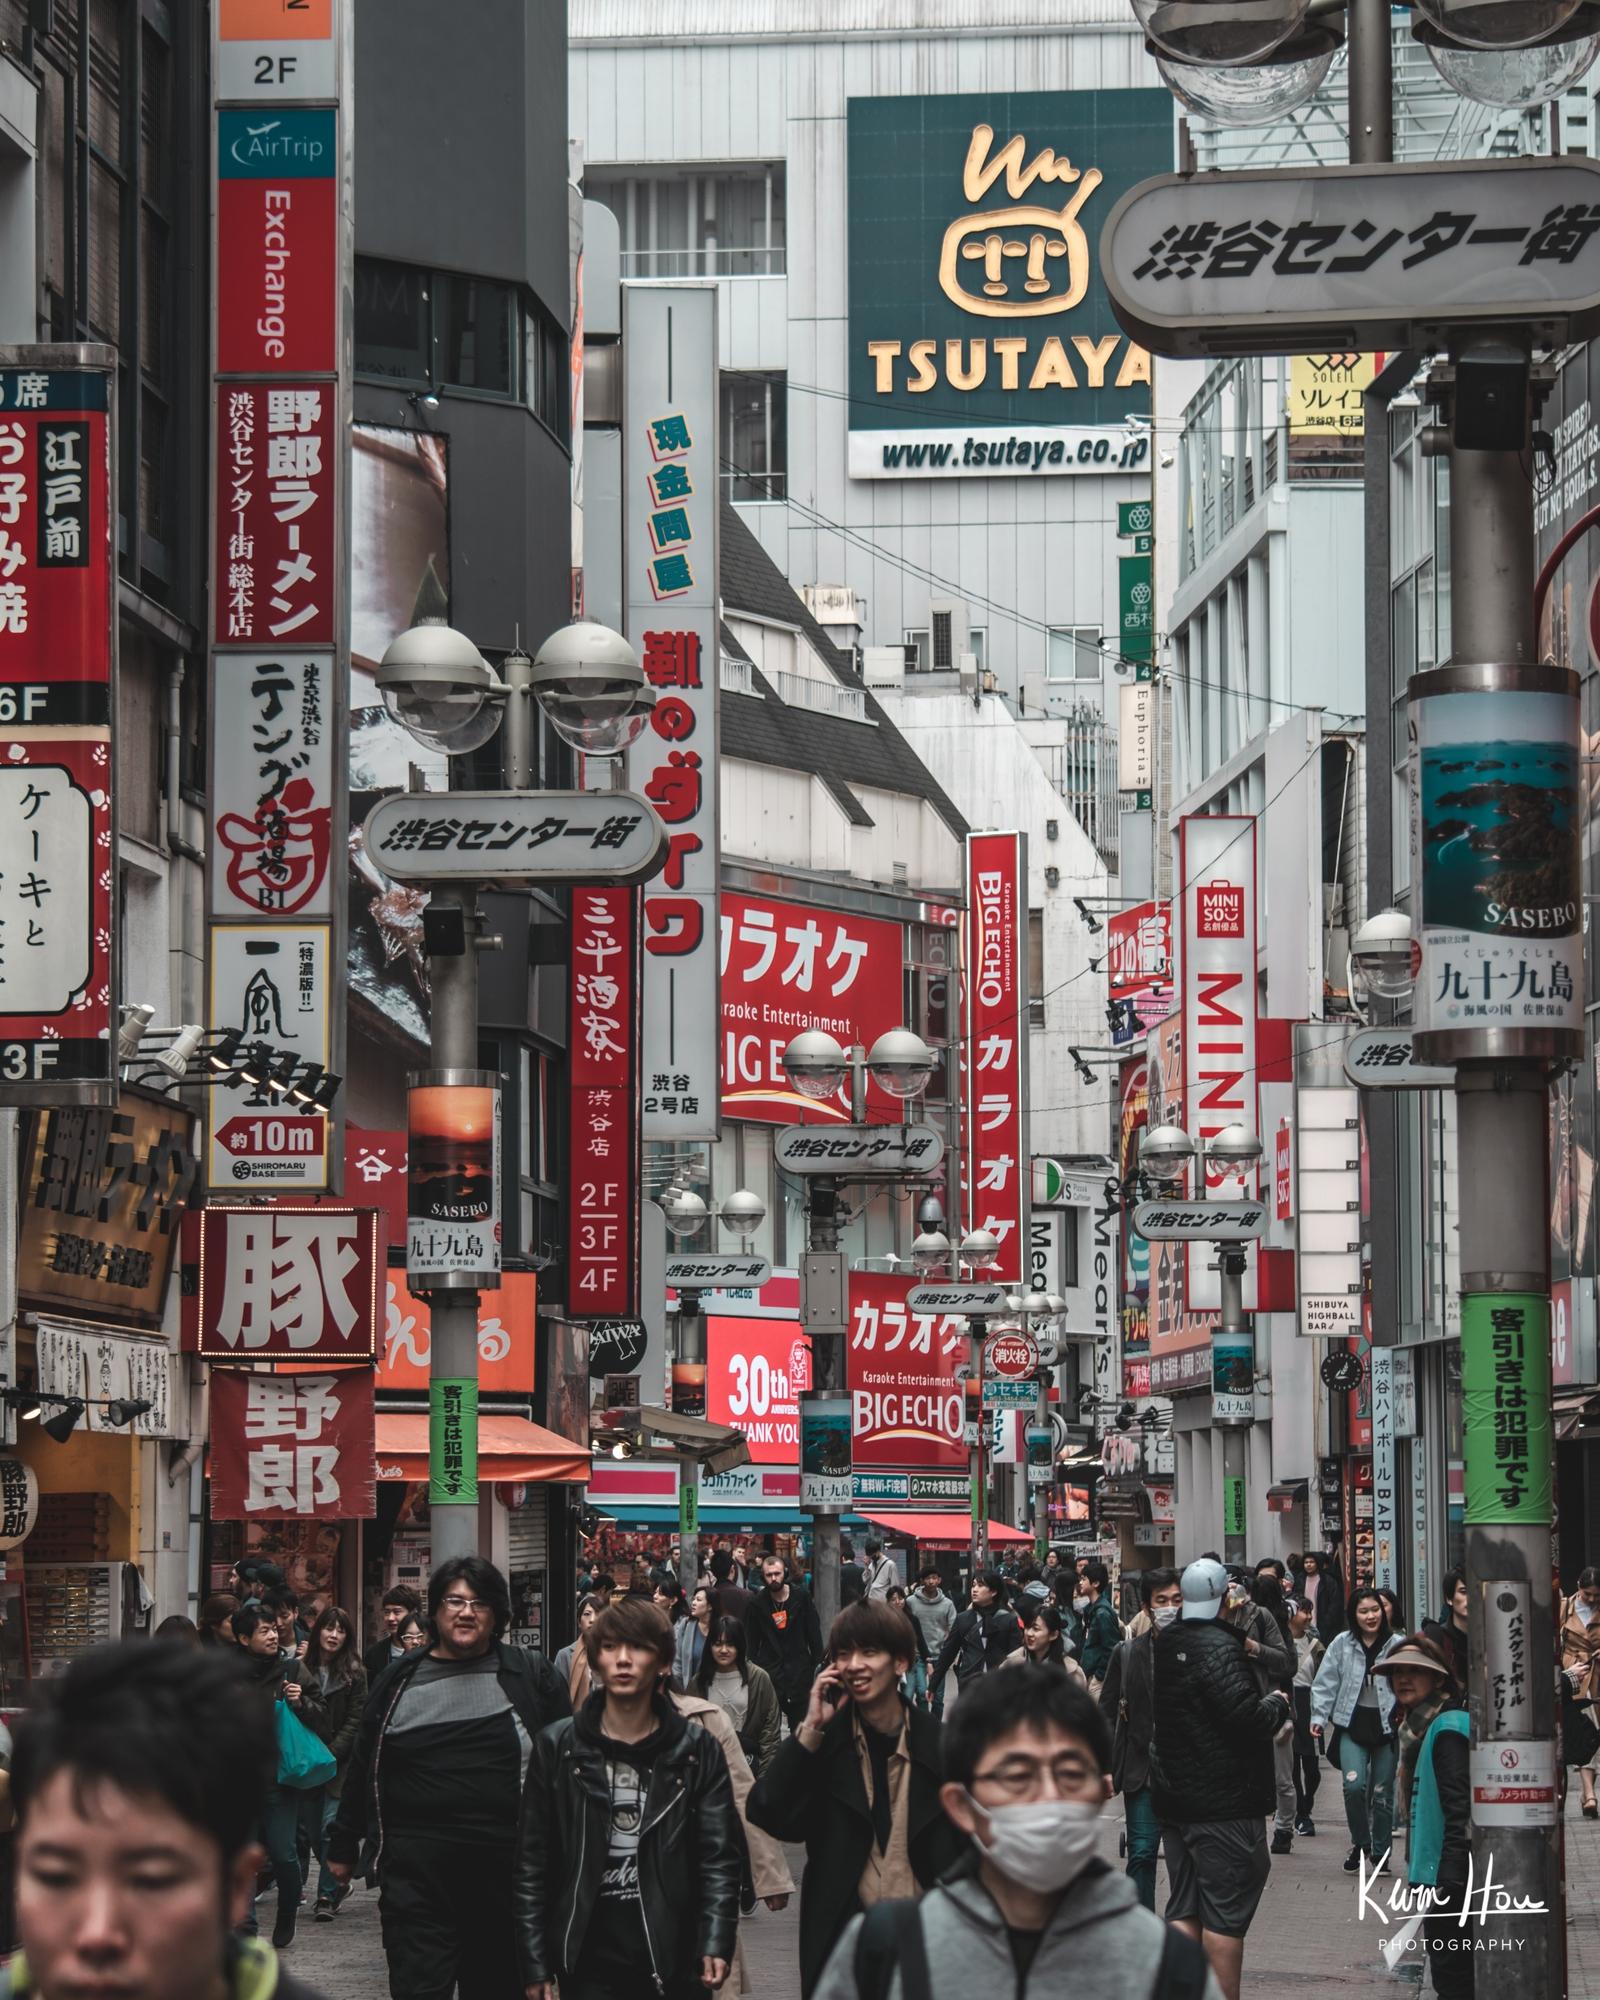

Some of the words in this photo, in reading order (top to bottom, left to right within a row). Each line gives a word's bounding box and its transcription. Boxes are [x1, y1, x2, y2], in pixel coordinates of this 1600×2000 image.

[254, 56, 297, 84] 2F
[248, 136, 324, 161] AirTrip
[1133, 204, 1600, 281] 渋谷センター街
[258, 190, 291, 359] Exchange
[868, 336, 1150, 393] TSUTAYA
[1313, 369, 1354, 383] SOLEIL
[883, 436, 1147, 470] www.tsutaya.co.jp
[228, 392, 255, 560] 渋谷センター街
[46, 431, 82, 559] 江戸前
[267, 391, 322, 636] 野郎ラーメン
[1140, 539, 1149, 550] 5
[228, 563, 255, 637] 総本店
[1141, 666, 1150, 678] 4
[301, 662, 322, 746] 東京渋谷
[1136, 690, 1149, 772] Euphoria
[379, 816, 642, 850] 渋谷センター街
[19, 784, 51, 948] ケーキと
[1203, 893, 1239, 907] MINI
[1484, 902, 1577, 928] SASEBO
[1435, 960, 1573, 1003] 九十九島
[243, 941, 298, 1107] 一風
[721, 1001, 758, 1021] raoke
[763, 1003, 851, 1034] Entertainment
[3, 1044, 60, 1080] 3F
[1355, 1044, 1412, 1067] 渋谷
[652, 1074, 691, 1092] 渋谷
[644, 1096, 699, 1115] 2号店
[588, 1089, 613, 1157] 渋谷店
[784, 1139, 933, 1158] 渋谷センター街
[252, 1162, 306, 1170] SHIROMARU
[356, 1148, 408, 1182] 谷
[430, 1201, 488, 1218] SASEBO
[581, 1183, 618, 1206] 2F
[1142, 1211, 1261, 1228] 渋谷センター街
[410, 1235, 483, 1258] 九十九島
[581, 1226, 618, 1249] 3F
[216, 1214, 360, 1349] 豚
[580, 1268, 618, 1292] 4F
[666, 1263, 765, 1278] 渋谷センター街
[914, 1293, 1000, 1305] 渋谷センター街
[1307, 1301, 1349, 1309] SHIBUYA
[1307, 1312, 1356, 1320] HIGHBALL
[1307, 1322, 1327, 1331] BAR
[995, 1347, 1028, 1365] 消火栓
[728, 1354, 788, 1416] 30th
[863, 1371, 894, 1384] Karaoke
[898, 1372, 955, 1387] Entertainment
[1216, 1399, 1252, 1413] 九十九島
[1374, 1359, 1392, 1481] 渋谷ハイボール
[1490, 1307, 1529, 1509] 客引きは犯罪です
[244, 1376, 342, 1514] 野郎
[443, 1385, 463, 1496] 客引きは犯罪です
[807, 1484, 850, 1498] 九十九島
[1377, 1488, 1392, 1532] BAR
[1508, 1612, 1526, 1708] バスケットボール
[1492, 1674, 1508, 1732] ストリート
